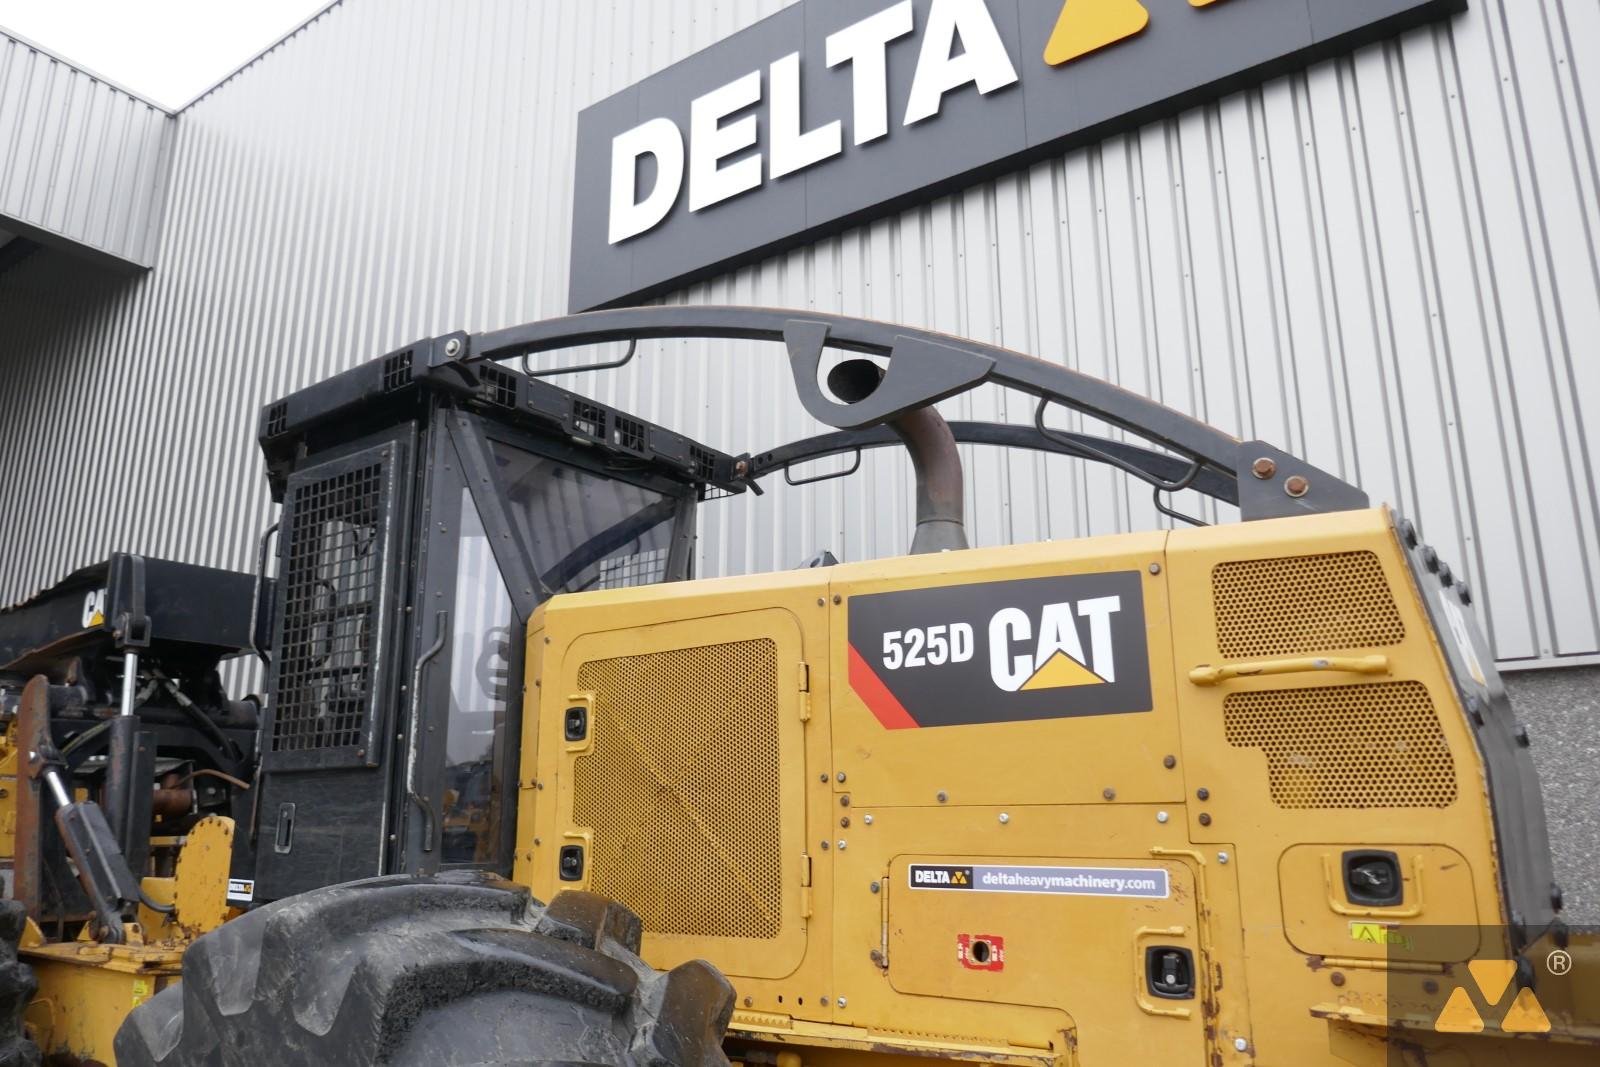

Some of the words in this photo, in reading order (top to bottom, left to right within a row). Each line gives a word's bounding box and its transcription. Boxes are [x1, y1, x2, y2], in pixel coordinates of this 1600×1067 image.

[608, 0, 1019, 245] DELTA
[82, 588, 108, 628] CA
[882, 622, 974, 670] 525D
[988, 595, 1121, 692] CAT
[915, 870, 950, 884] DELTA
[982, 872, 1156, 891] deltaheavymachinery.com
